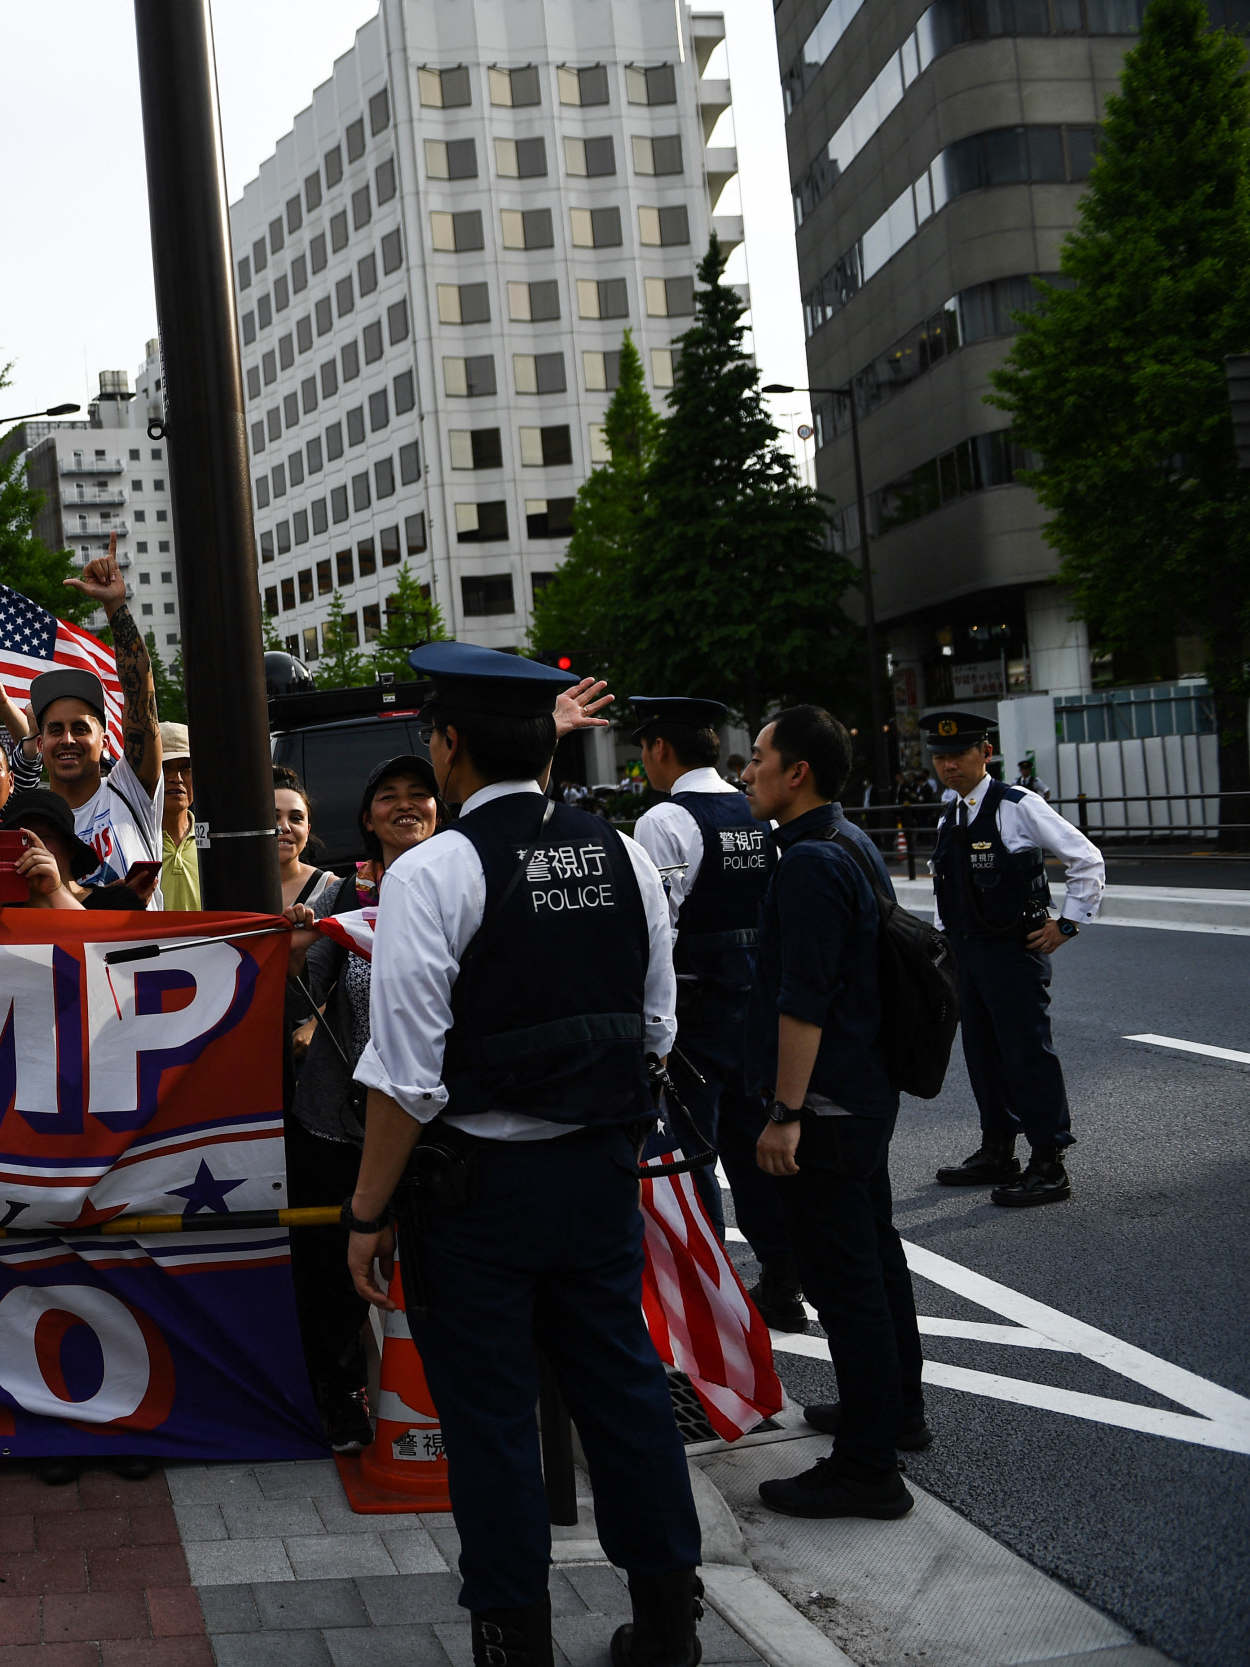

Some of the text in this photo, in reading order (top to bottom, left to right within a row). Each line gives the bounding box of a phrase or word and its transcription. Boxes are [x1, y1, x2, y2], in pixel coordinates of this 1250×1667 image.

[719, 830, 764, 851] 警視庁
[517, 843, 607, 882] 警視庁
[724, 855, 765, 870] POLICE
[970, 853, 995, 862] 警視庁
[532, 885, 614, 912] POLICE
